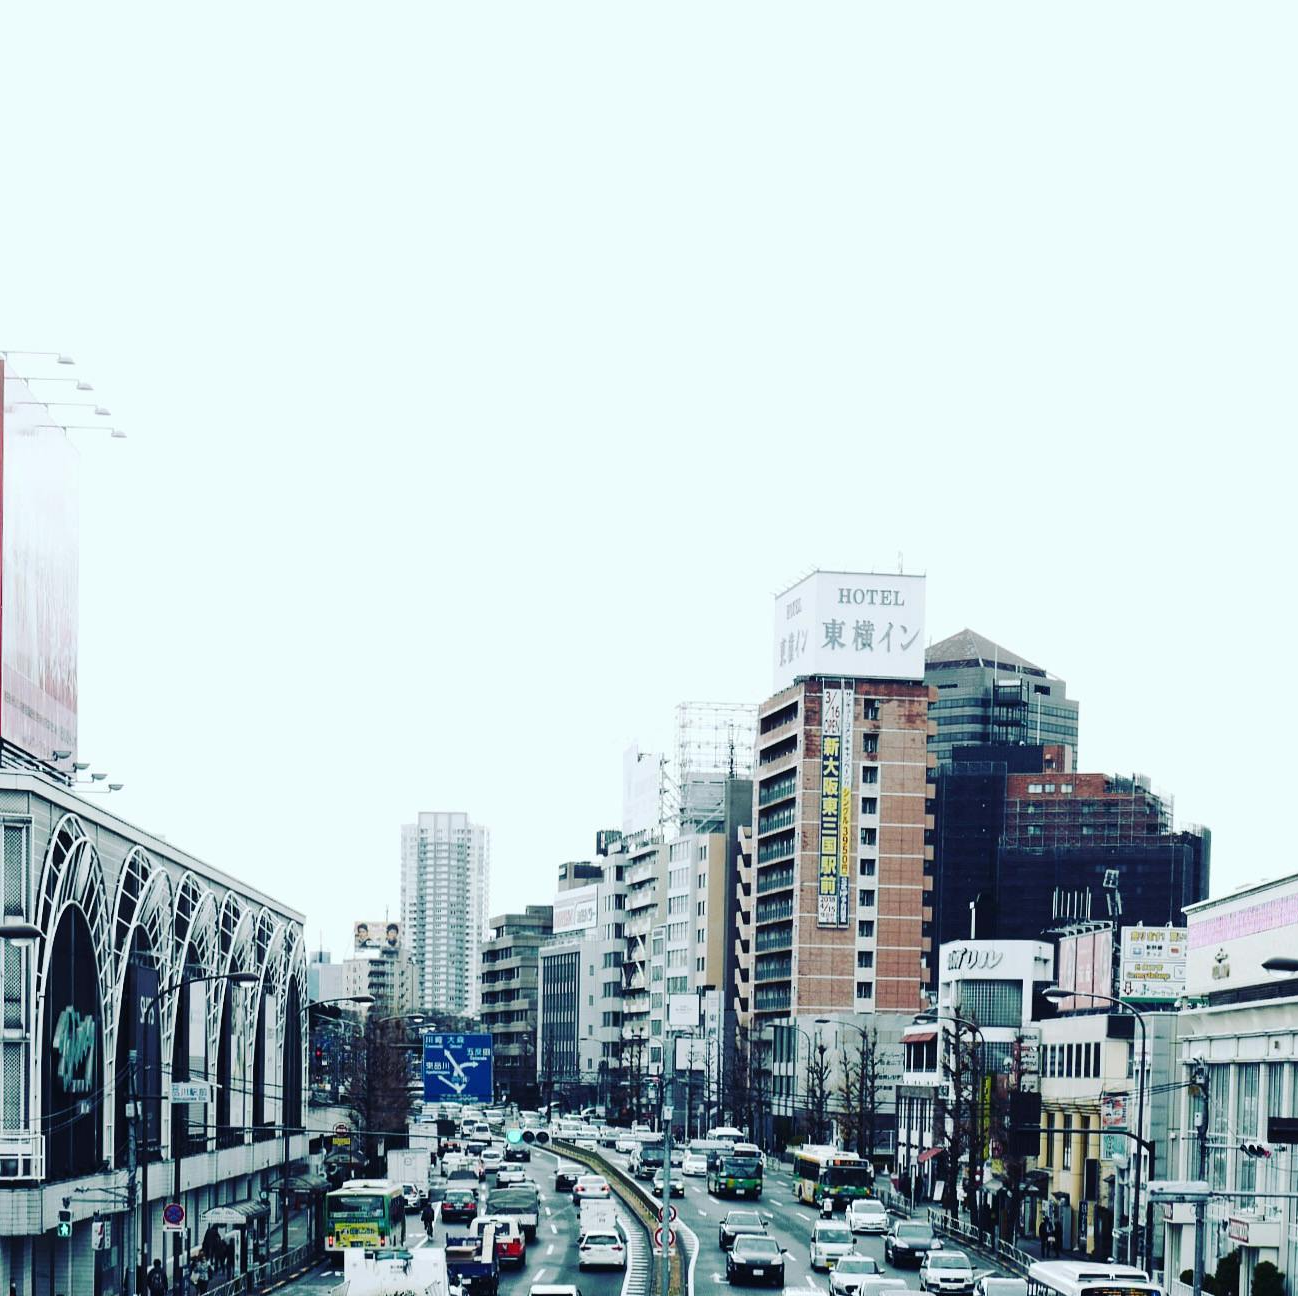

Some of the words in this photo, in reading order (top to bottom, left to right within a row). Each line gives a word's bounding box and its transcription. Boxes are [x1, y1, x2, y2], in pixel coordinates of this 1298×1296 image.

[838, 588, 905, 606] HOTEL
[821, 618, 920, 652] 東横イン
[820, 736, 840, 895] 新大阪東三国駅前
